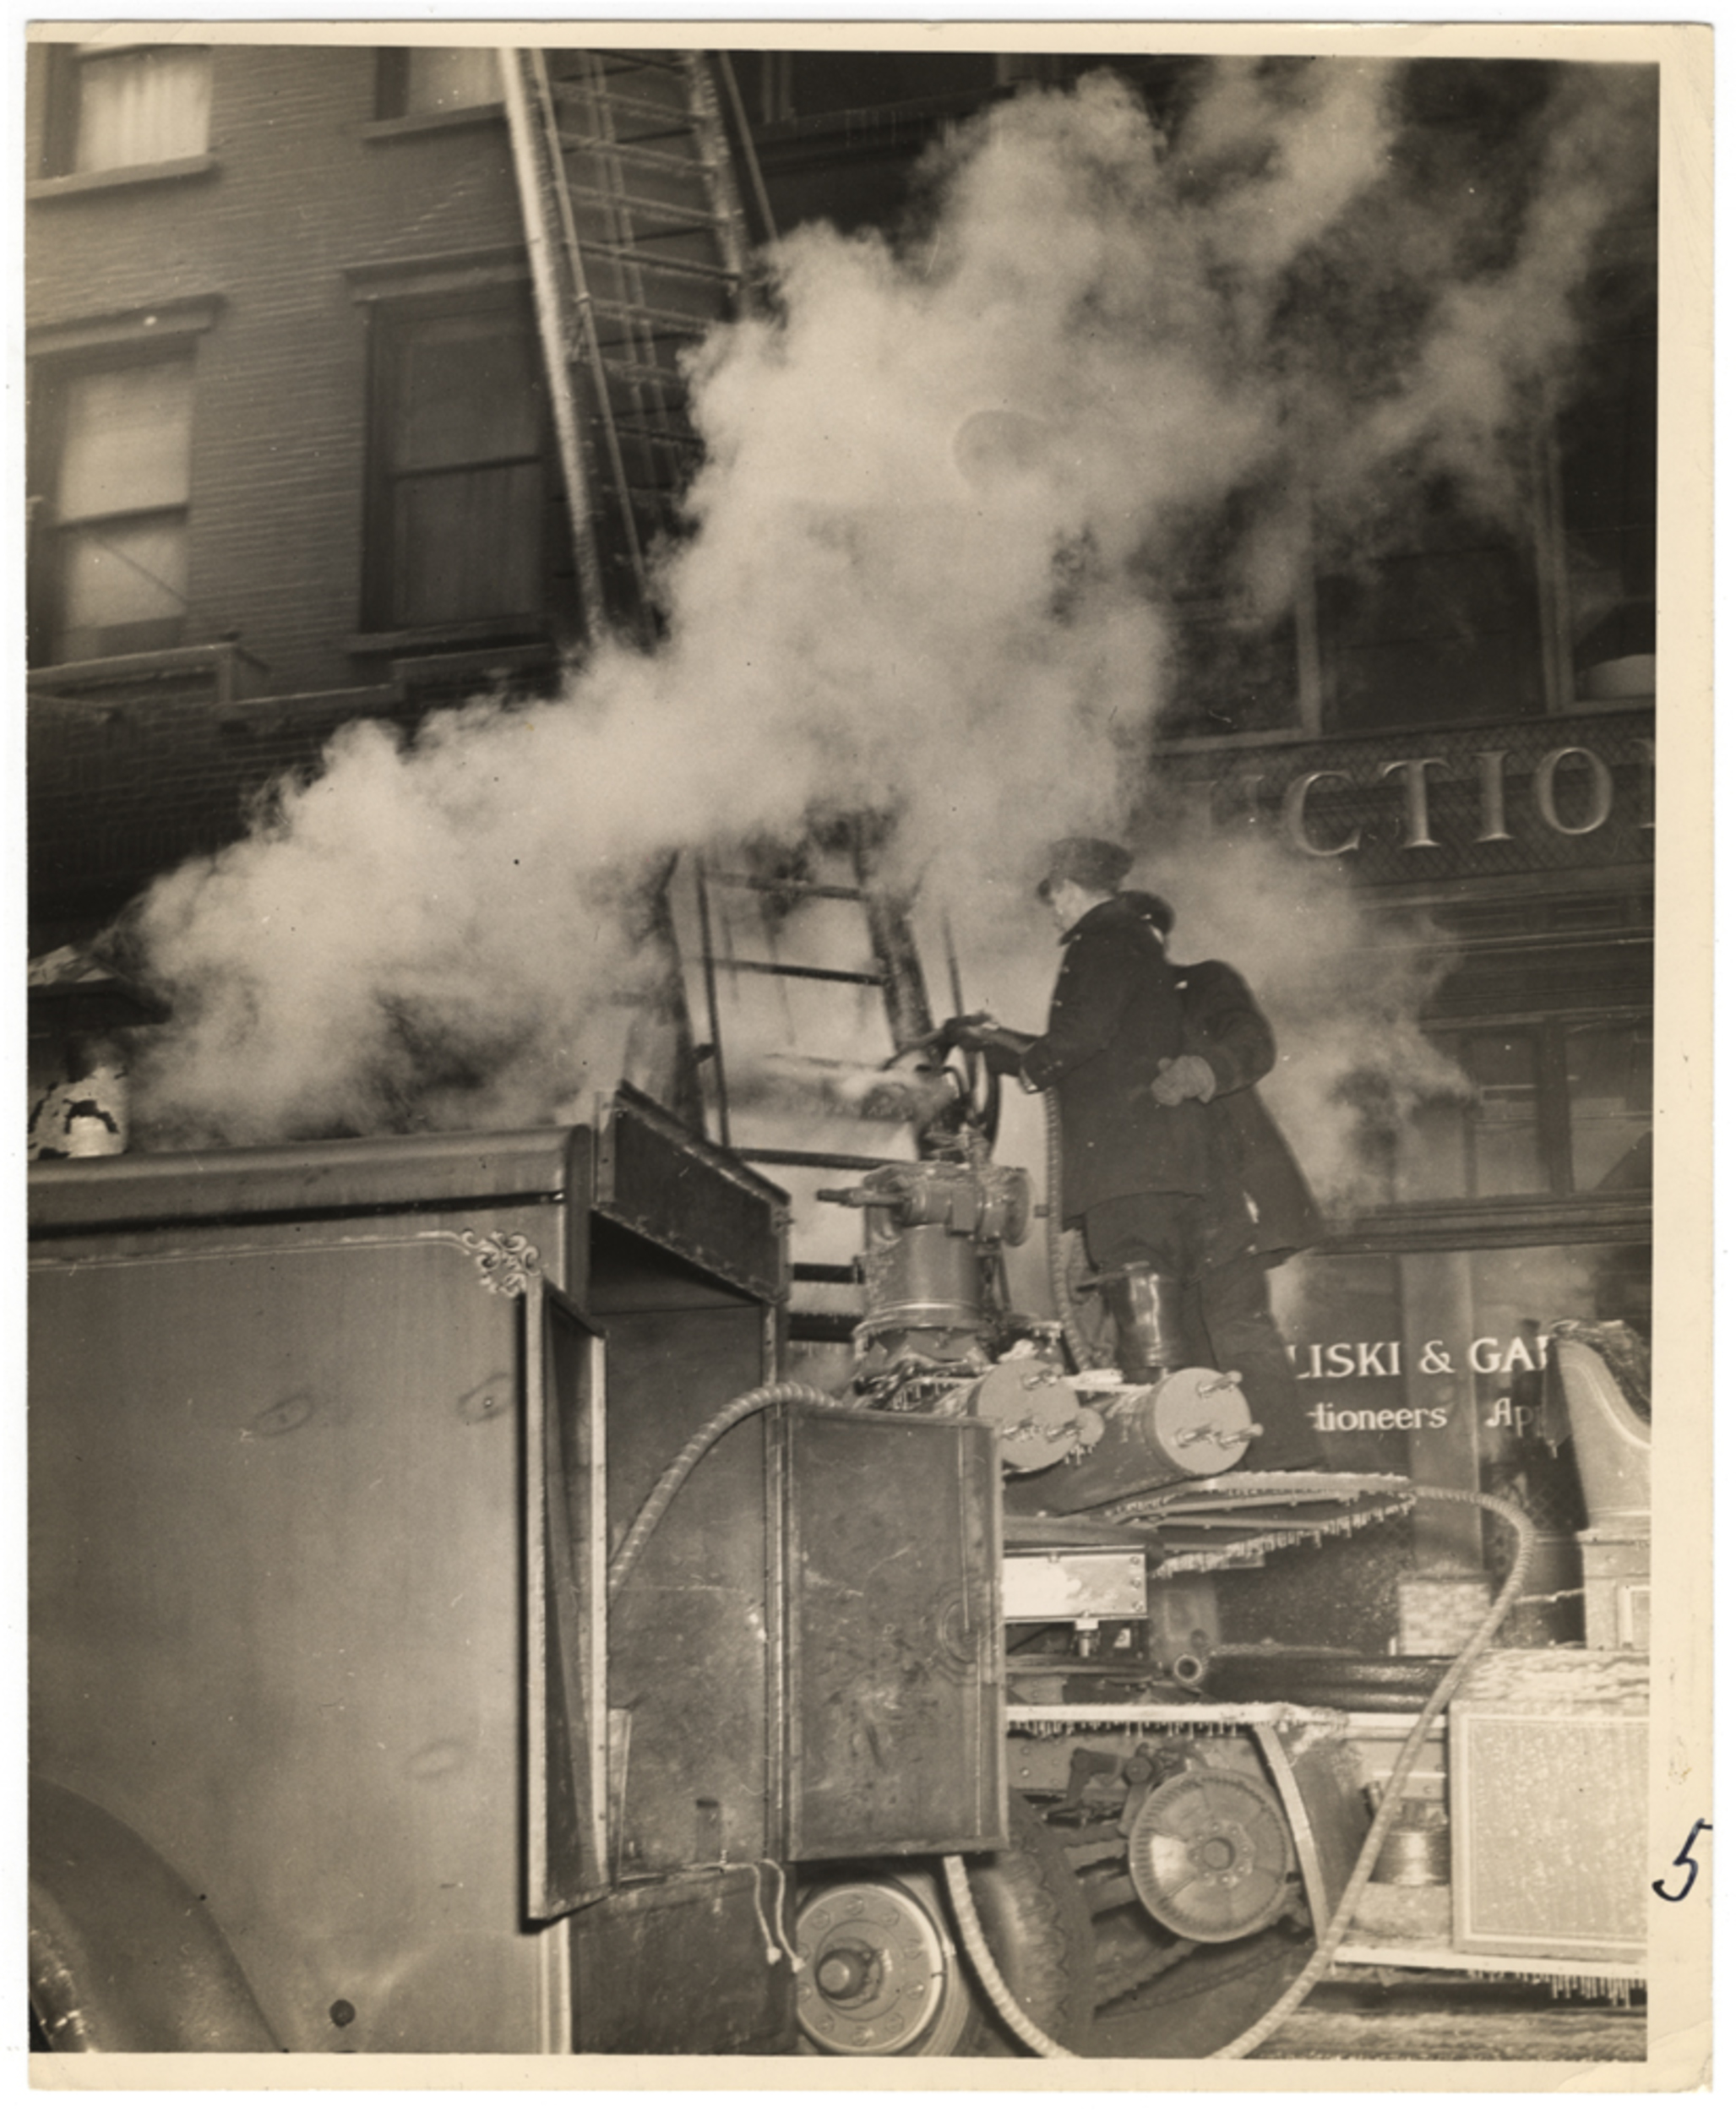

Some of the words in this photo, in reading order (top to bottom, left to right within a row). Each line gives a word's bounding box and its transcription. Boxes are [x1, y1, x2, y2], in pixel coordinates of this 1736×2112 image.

[1418, 1339, 1457, 1374] &
[1305, 1402, 1449, 1433] tioneers
[1652, 1817, 1713, 1902] 5
